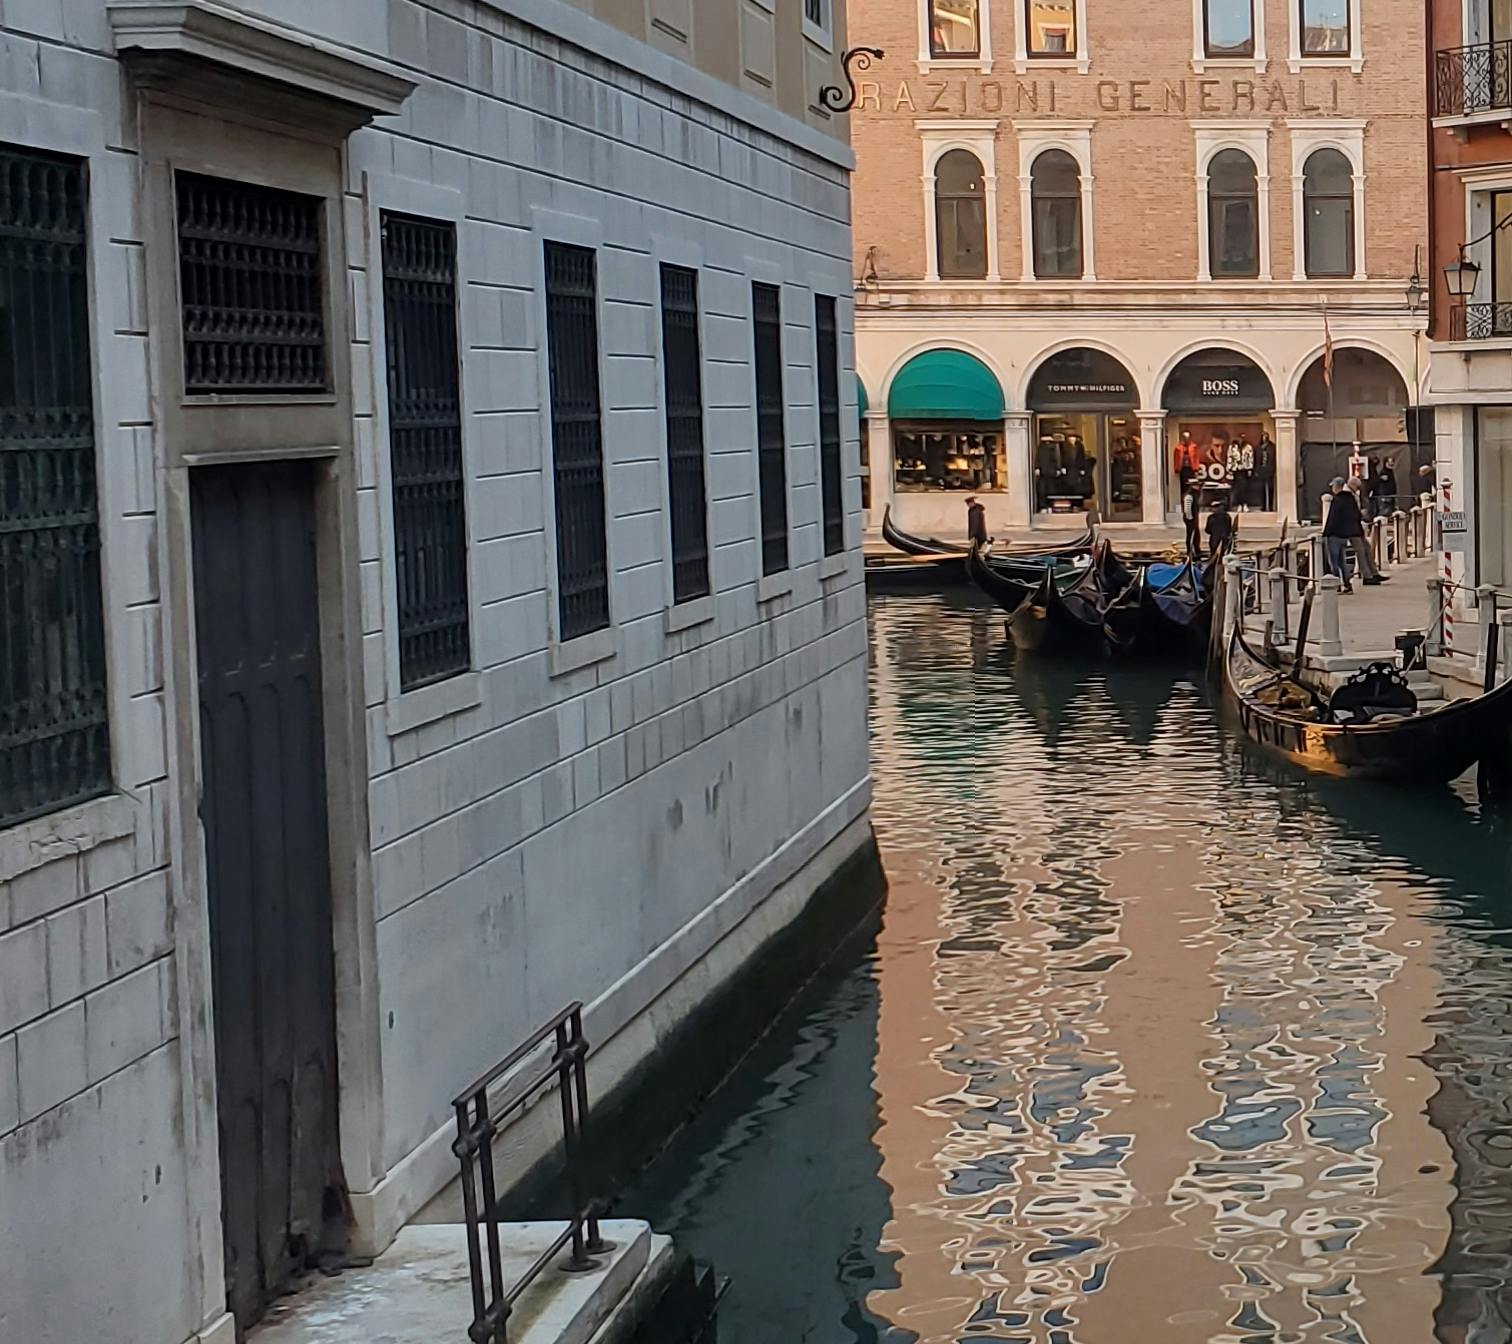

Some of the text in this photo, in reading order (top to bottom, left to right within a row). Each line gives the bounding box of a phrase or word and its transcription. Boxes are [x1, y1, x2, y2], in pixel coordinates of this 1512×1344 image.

[1096, 78, 1341, 112] GENERALI
[1048, 384, 1126, 392] TOMMY HILFIGER
[1202, 379, 1239, 392] BOSS
